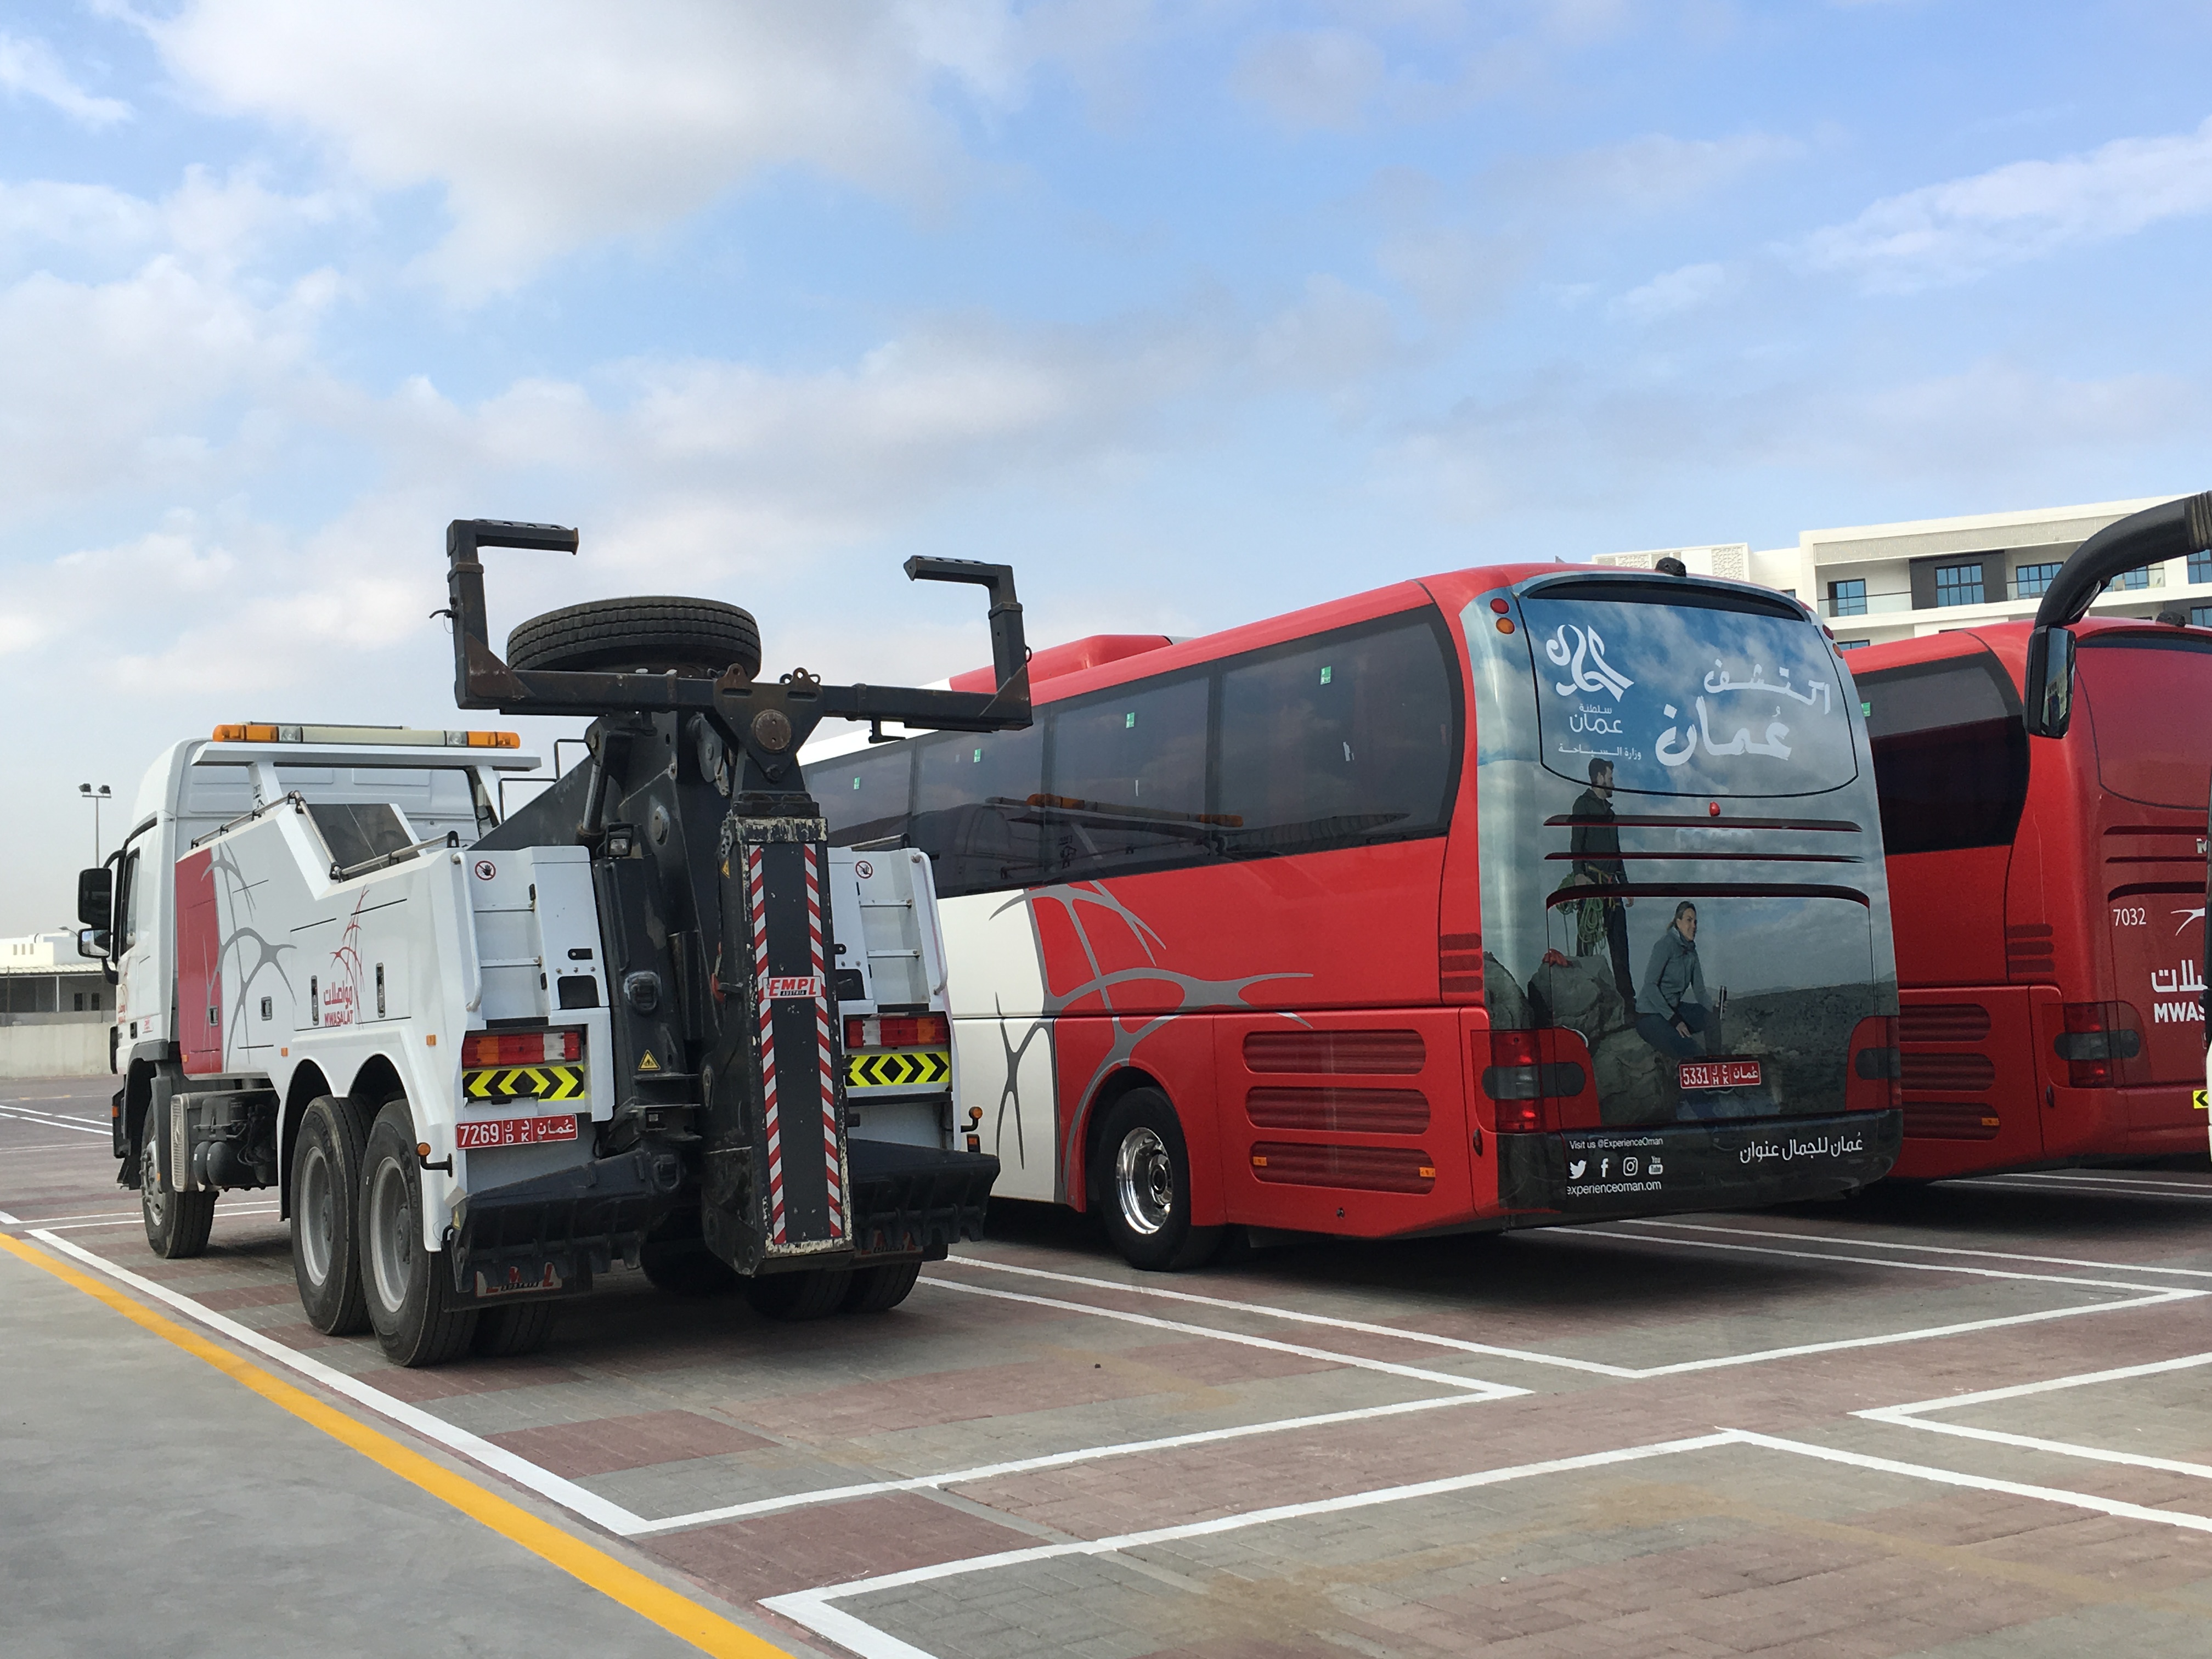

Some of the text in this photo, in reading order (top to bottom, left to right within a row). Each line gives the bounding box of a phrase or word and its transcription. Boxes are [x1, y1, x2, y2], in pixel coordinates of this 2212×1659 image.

[1579, 703, 1612, 714] سلطنة
[1570, 714, 1623, 734] عمان
[1624, 747, 1641, 760] وزارة
[2113, 907, 2146, 926] 7032
[324, 980, 353, 1009] مواصلات
[769, 979, 816, 996] EMPL
[324, 1009, 353, 1027] MWASALAT
[1683, 1067, 1709, 1085] 5331
[460, 1124, 499, 1145] 7269
[1570, 1141, 1585, 1149] Visit
[1598, 1137, 1663, 1149] @ExperienceOman
[1740, 1141, 1779, 1163] عنوان
[1782, 1137, 1827, 1160] للجمال
[1567, 1181, 1661, 1197] experienceoman.om
